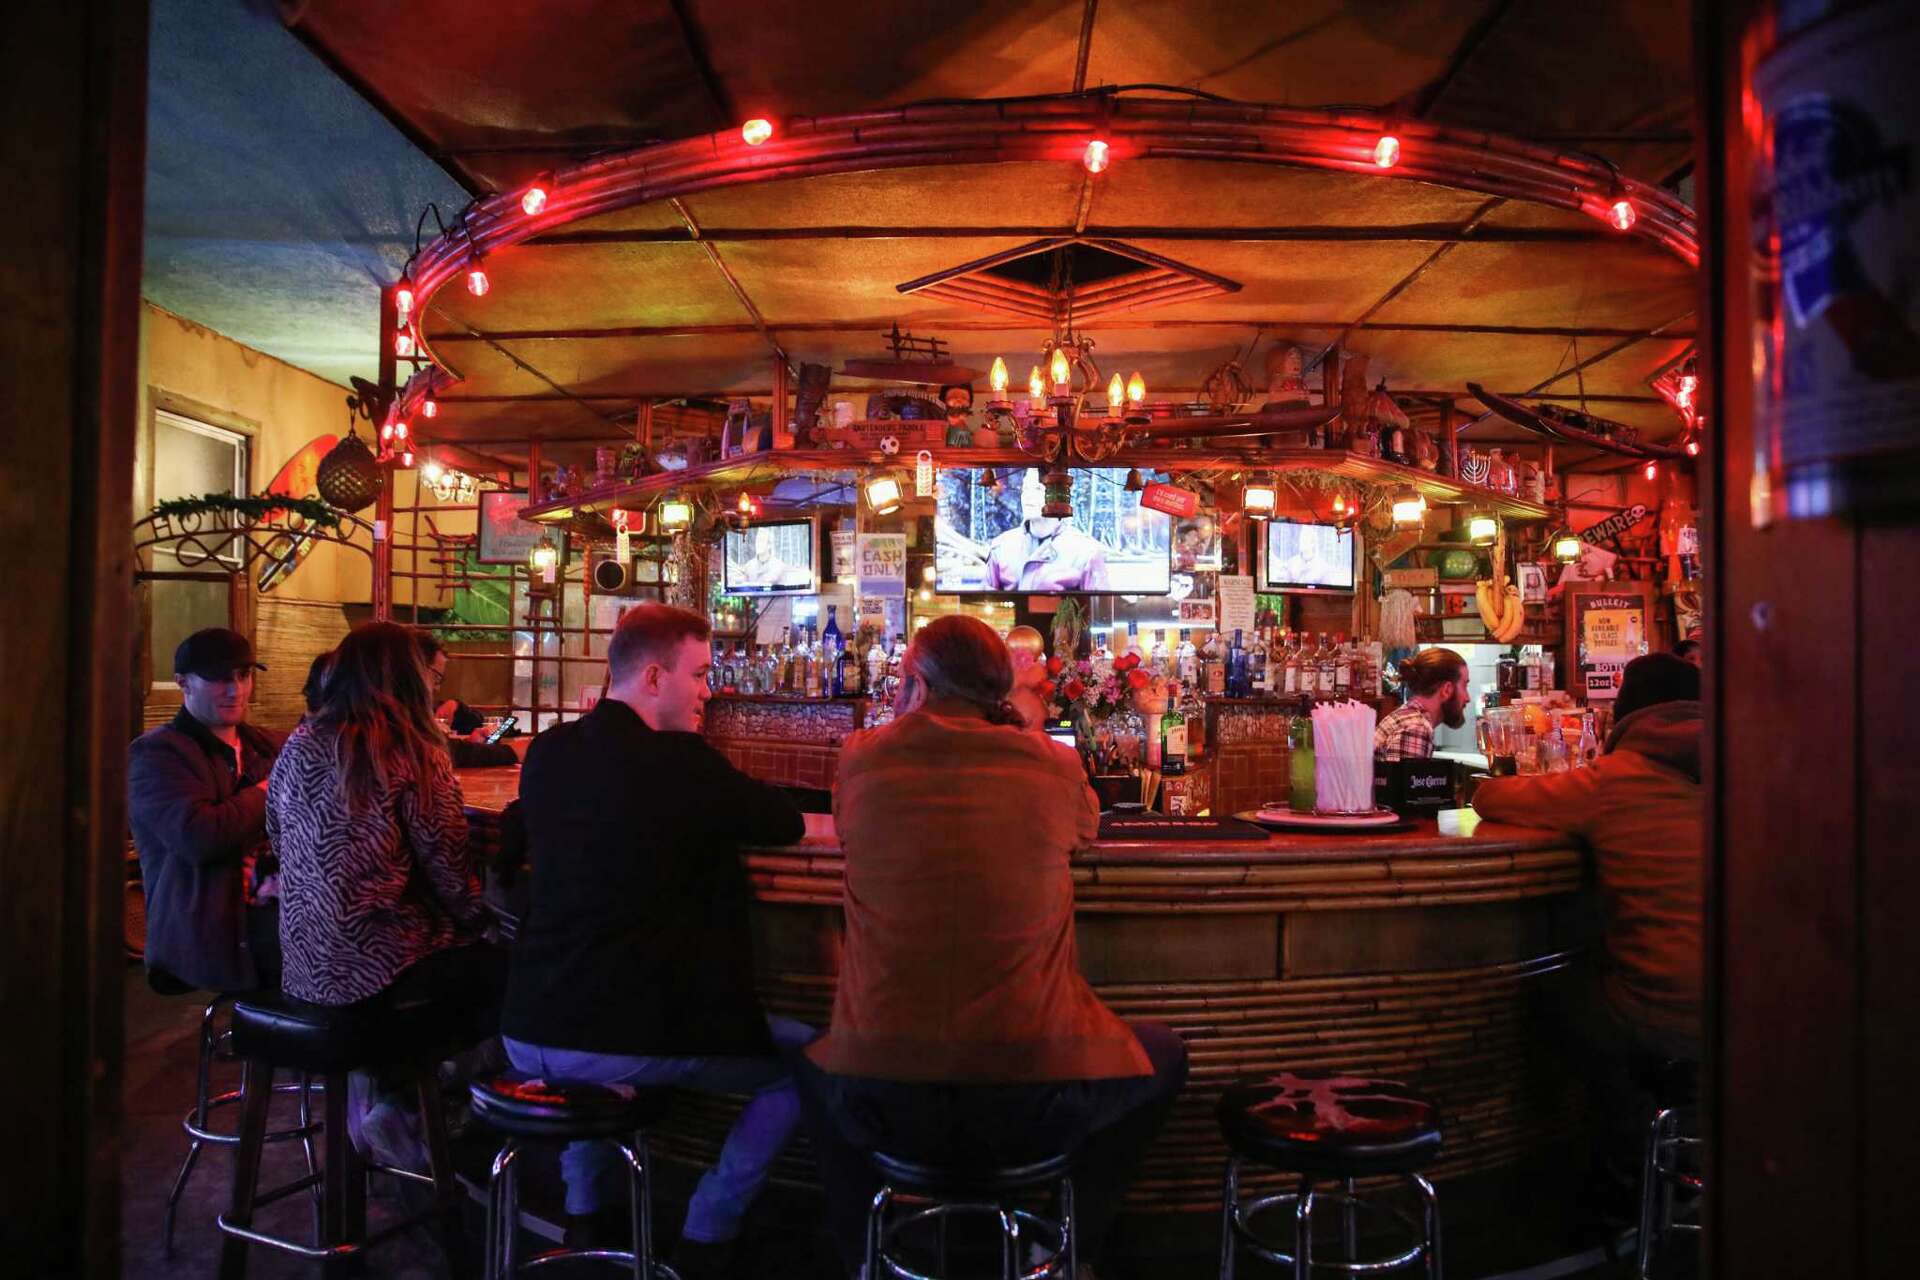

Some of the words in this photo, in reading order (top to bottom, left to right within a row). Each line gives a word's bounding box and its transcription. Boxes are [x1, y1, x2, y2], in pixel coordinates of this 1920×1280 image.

[150, 508, 358, 541] HONOLUU
[1579, 510, 1636, 545] EWARE
[863, 550, 903, 562] CASH
[863, 563, 904, 576] ONLY
[1589, 598, 1630, 609] BULLEIT
[1595, 663, 1624, 672] BOTTL
[1410, 775, 1425, 789] Jose
